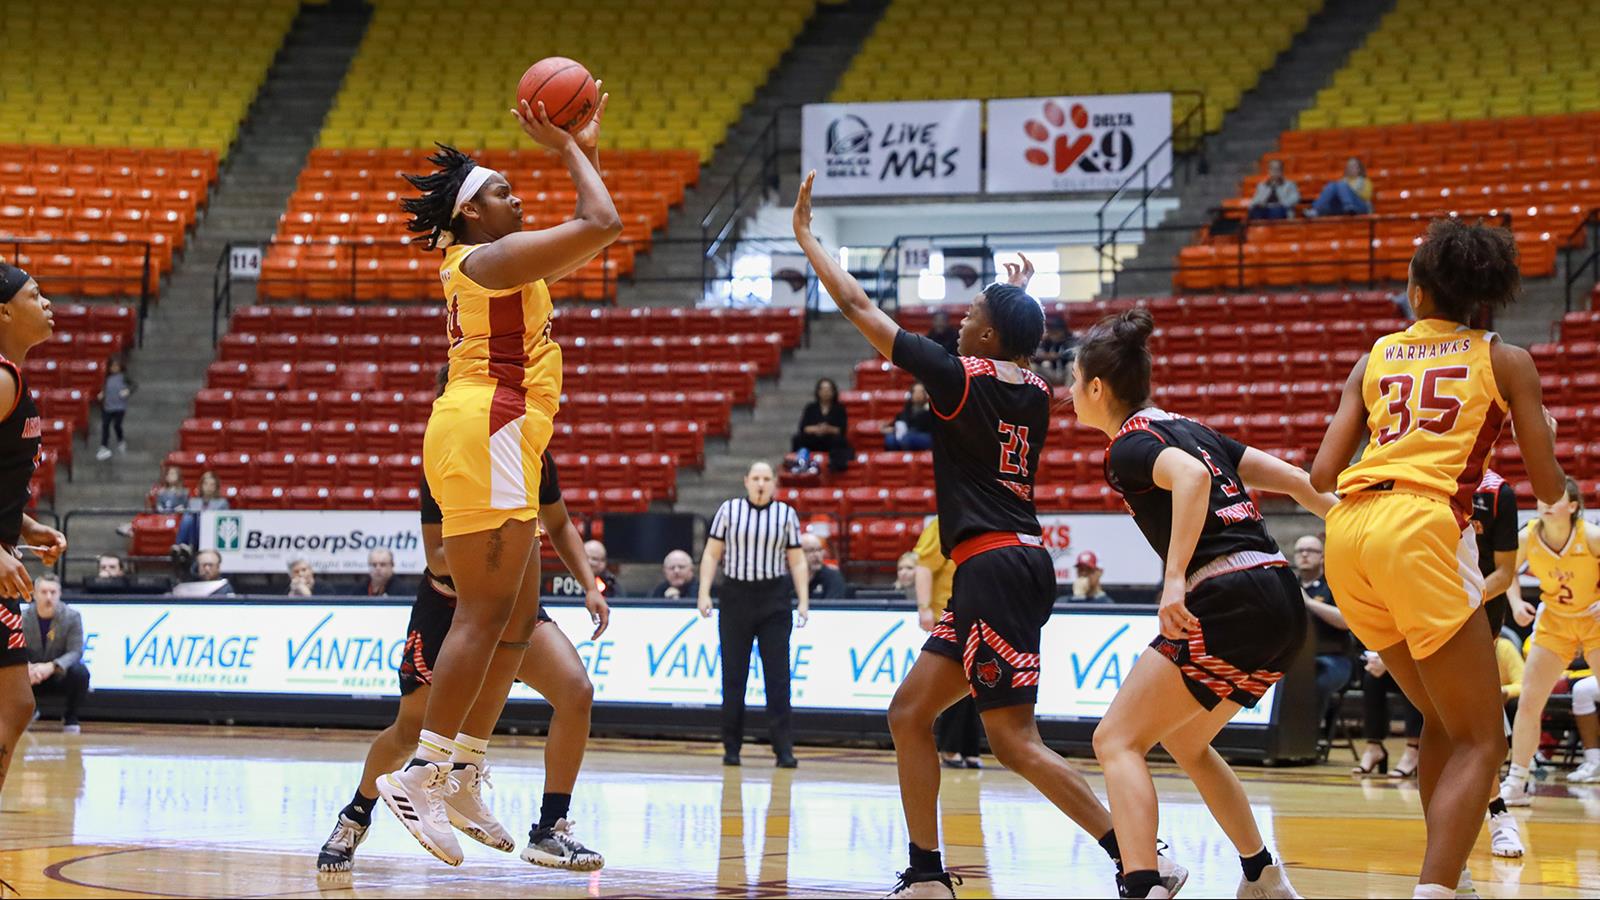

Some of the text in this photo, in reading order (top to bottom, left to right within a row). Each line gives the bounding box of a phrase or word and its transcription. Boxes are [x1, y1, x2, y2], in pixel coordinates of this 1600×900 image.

[1093, 113, 1134, 127] DELTA
[826, 157, 871, 166] TACO
[826, 169, 870, 177] BELL
[233, 253, 258, 269] 114
[904, 248, 930, 266] 115
[1384, 338, 1471, 361] WARHAWKS
[1377, 366, 1469, 446] 35
[998, 419, 1030, 477] 21
[245, 530, 418, 553] BancorpSouth
[1558, 584, 1574, 605] 2
[123, 611, 260, 669] VANTAGE
[286, 612, 407, 672] VANTAG
[175, 674, 216, 684] HEALTH
